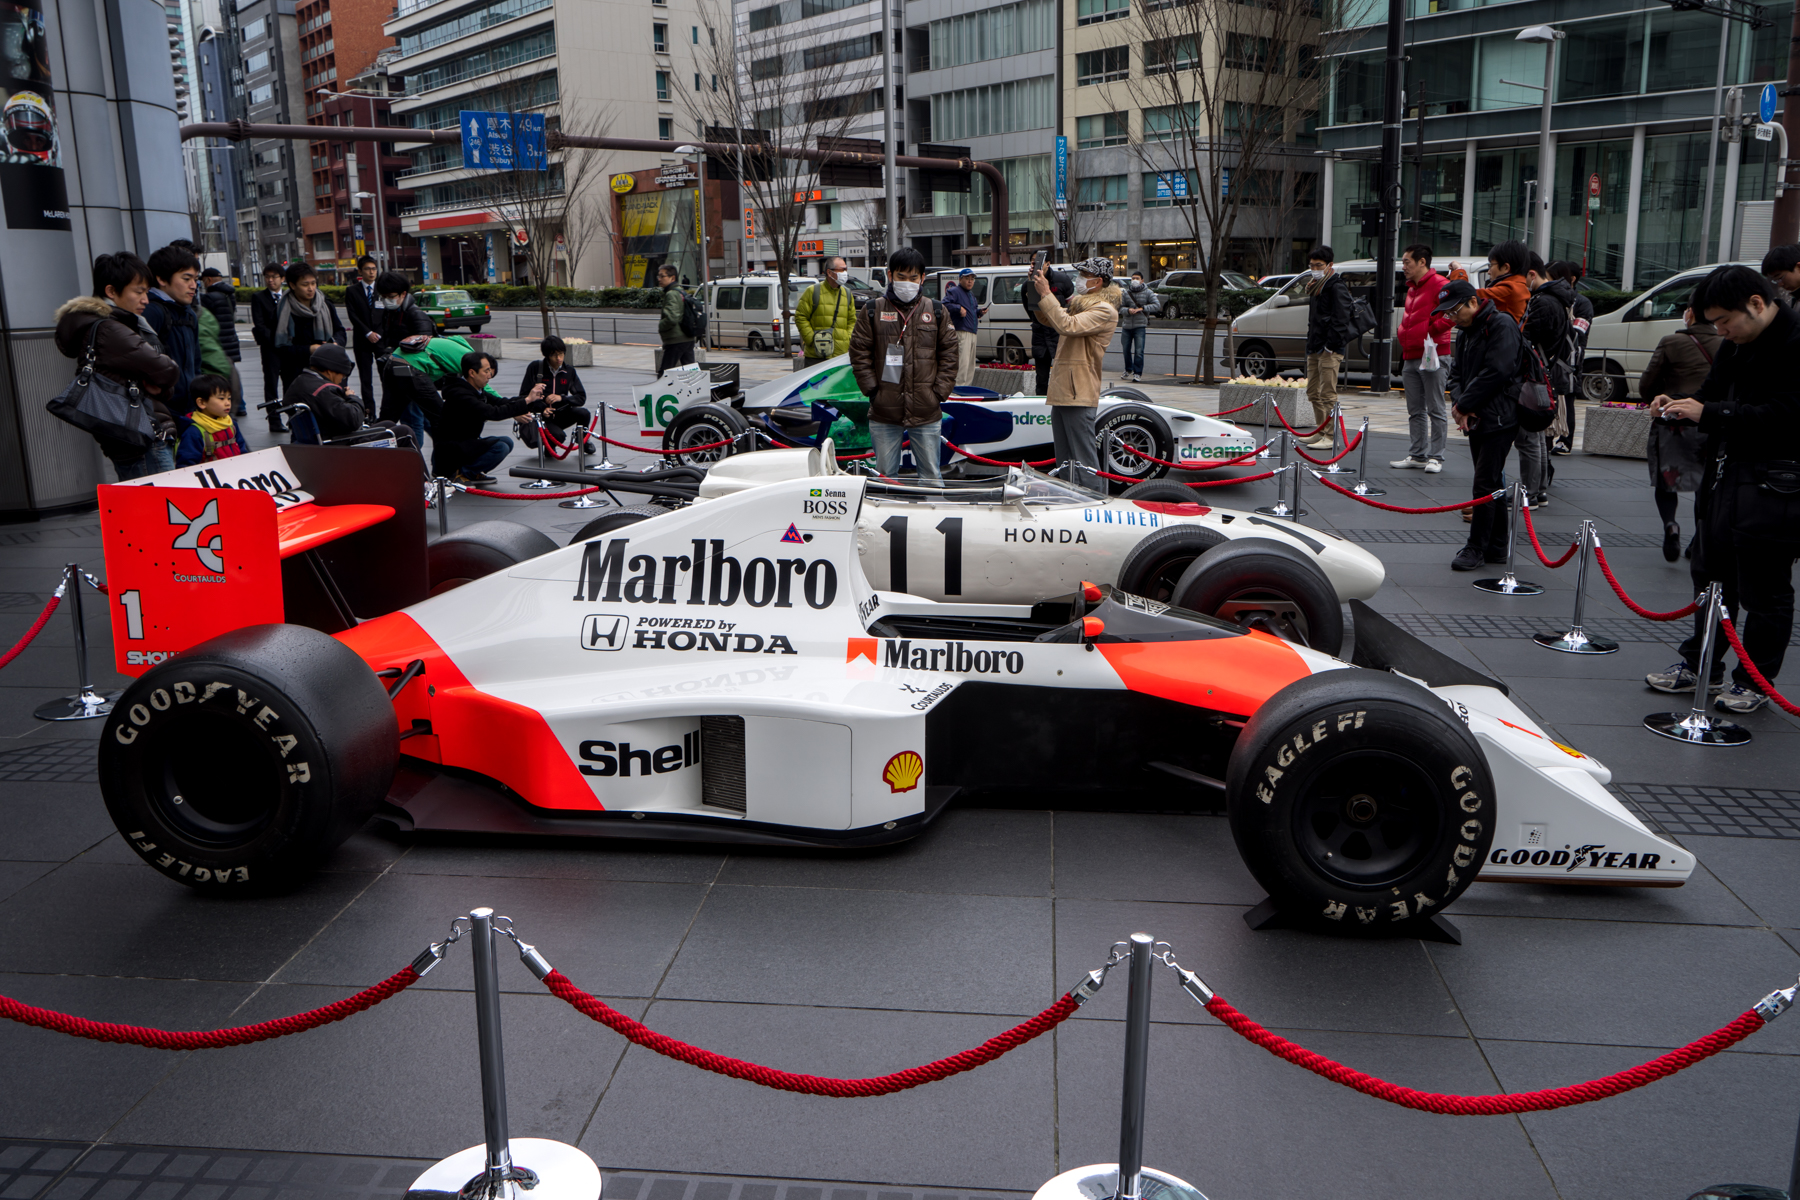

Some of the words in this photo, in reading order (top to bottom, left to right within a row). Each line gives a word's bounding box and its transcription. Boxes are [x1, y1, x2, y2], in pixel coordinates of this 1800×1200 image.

[487, 117, 511, 130] 厚木
[489, 143, 513, 156] 渋谷
[639, 394, 680, 428] 16
[1181, 443, 1255, 459] dreams
[824, 488, 846, 498] Senna
[803, 500, 848, 515] BOSS
[1084, 508, 1160, 528] GINTHER
[1004, 527, 1089, 545] HONDA
[881, 515, 963, 596] 11
[173, 573, 226, 584] COURTAULDS
[573, 538, 838, 610] Marlboro
[119, 589, 145, 640] 1
[636, 617, 716, 630] POWERED
[718, 619, 736, 632] by
[632, 629, 798, 655] HONDA
[883, 639, 1024, 674] Marlboro
[910, 682, 954, 711] COURTAULDS
[578, 729, 700, 777] Shell
[1255, 720, 1328, 805] EAGLE
[156, 852, 250, 884] EAGLE
